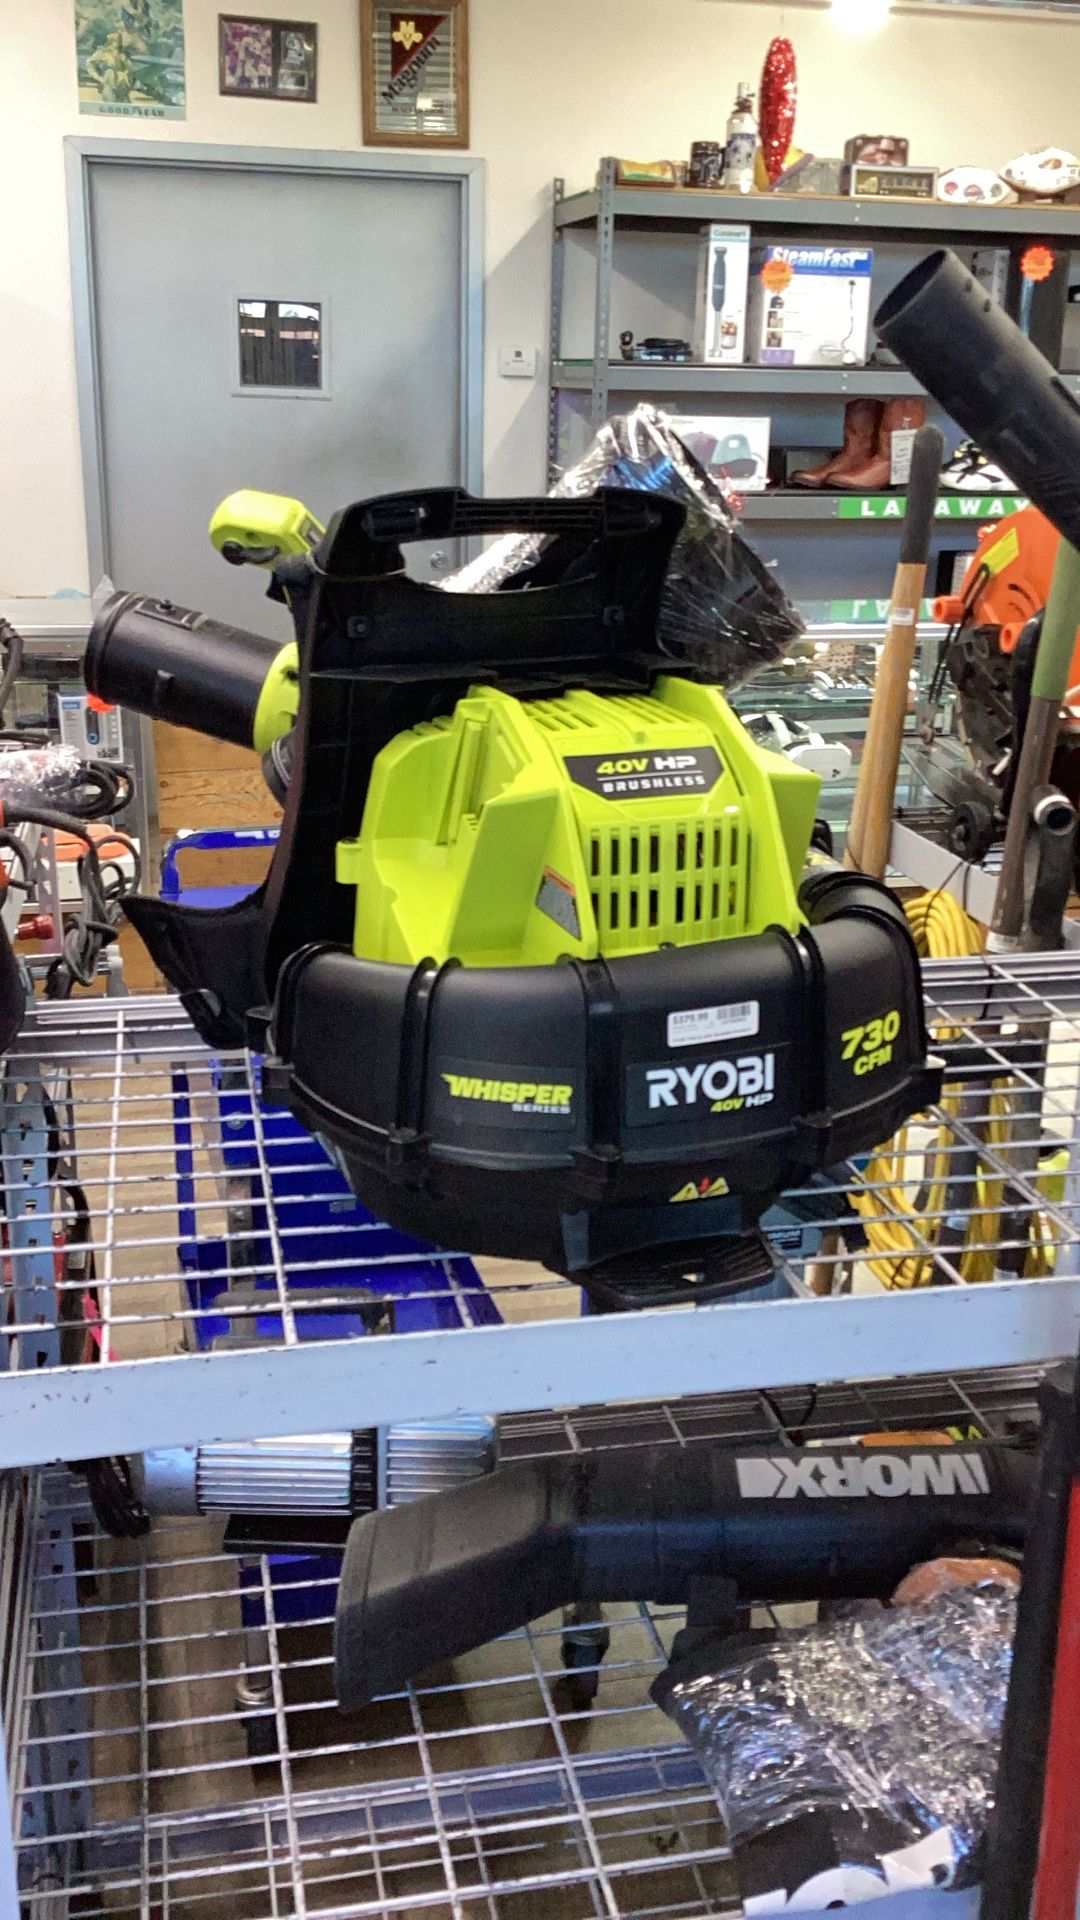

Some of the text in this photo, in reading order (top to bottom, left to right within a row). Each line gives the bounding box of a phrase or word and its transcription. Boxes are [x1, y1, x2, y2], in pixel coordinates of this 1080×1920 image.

[381, 36, 440, 106] Magnum
[860, 500, 1031, 517] LAAWAY
[596, 755, 697, 775] 40V HP
[602, 775, 706, 793] BRUSHLESS
[841, 1009, 901, 1061] 730
[440, 1073, 573, 1105] WHISPER
[645, 1053, 775, 1109] RYOBI
[511, 1102, 572, 1114] SERIES
[709, 1092, 775, 1113] 40V HP
[736, 1454, 991, 1499] WORX
